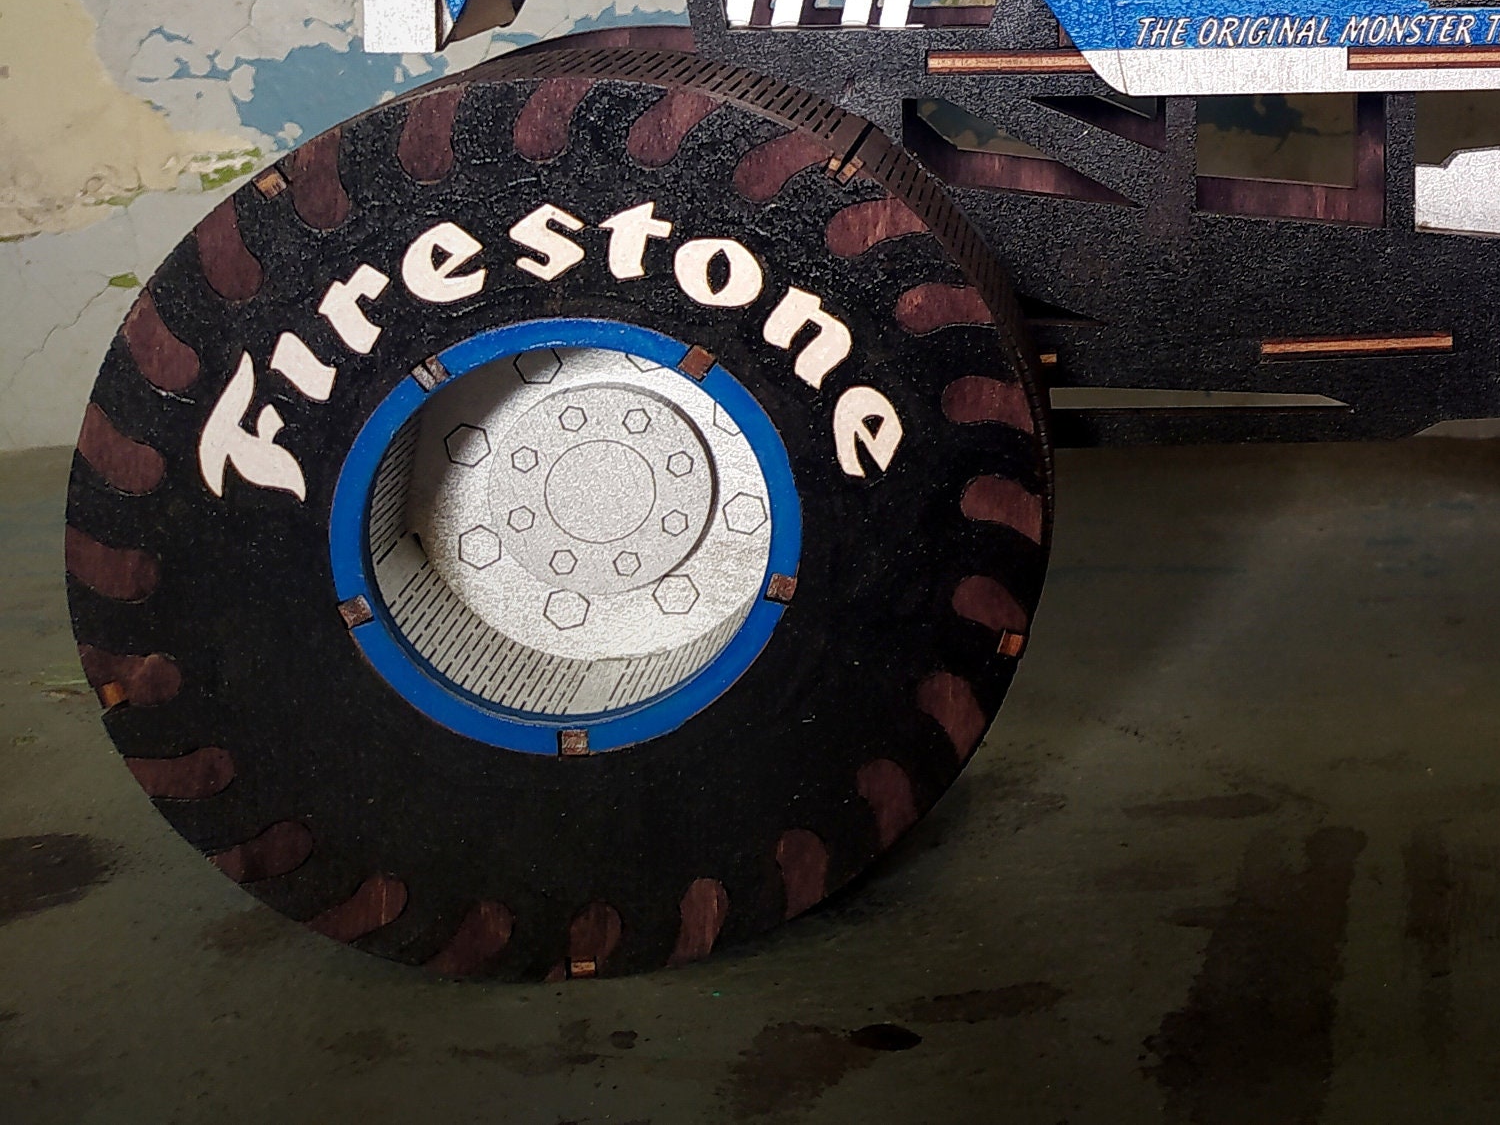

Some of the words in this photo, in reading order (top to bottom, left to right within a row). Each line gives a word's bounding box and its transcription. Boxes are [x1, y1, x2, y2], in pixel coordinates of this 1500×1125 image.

[1135, 16, 1187, 46] THE
[1197, 15, 1330, 46] ORIGINAL
[1340, 15, 1473, 46] MONSTER
[197, 201, 905, 504] Firestone
